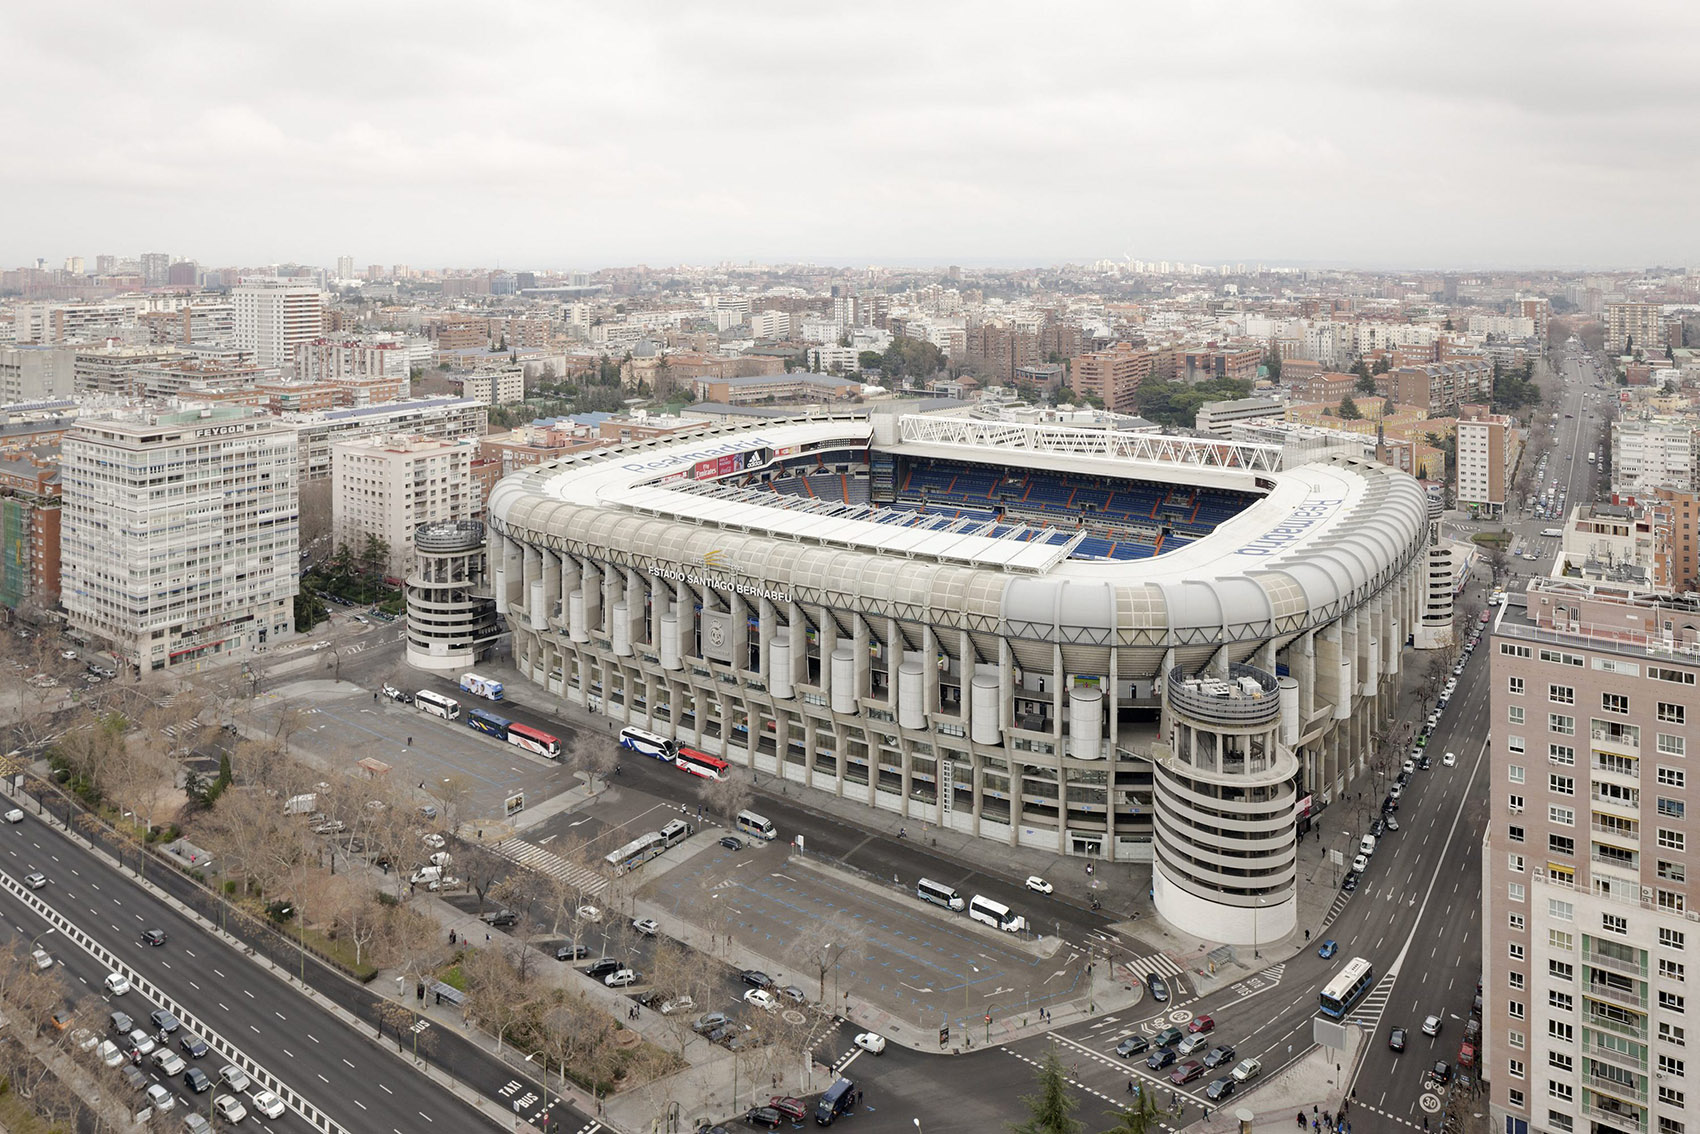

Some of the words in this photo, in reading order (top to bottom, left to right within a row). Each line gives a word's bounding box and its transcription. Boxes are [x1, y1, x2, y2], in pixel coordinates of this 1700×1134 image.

[196, 425, 245, 438] FEYGON
[746, 460, 764, 469] adidas
[648, 566, 686, 582] ESTADIO
[687, 574, 735, 593] SANTIAGO
[736, 583, 793, 604] BERNABEU
[410, 1019, 431, 1034] BUS
[498, 1080, 523, 1098] TAXI
[517, 1092, 539, 1109] BUS
[1424, 1096, 1437, 1109] 30
